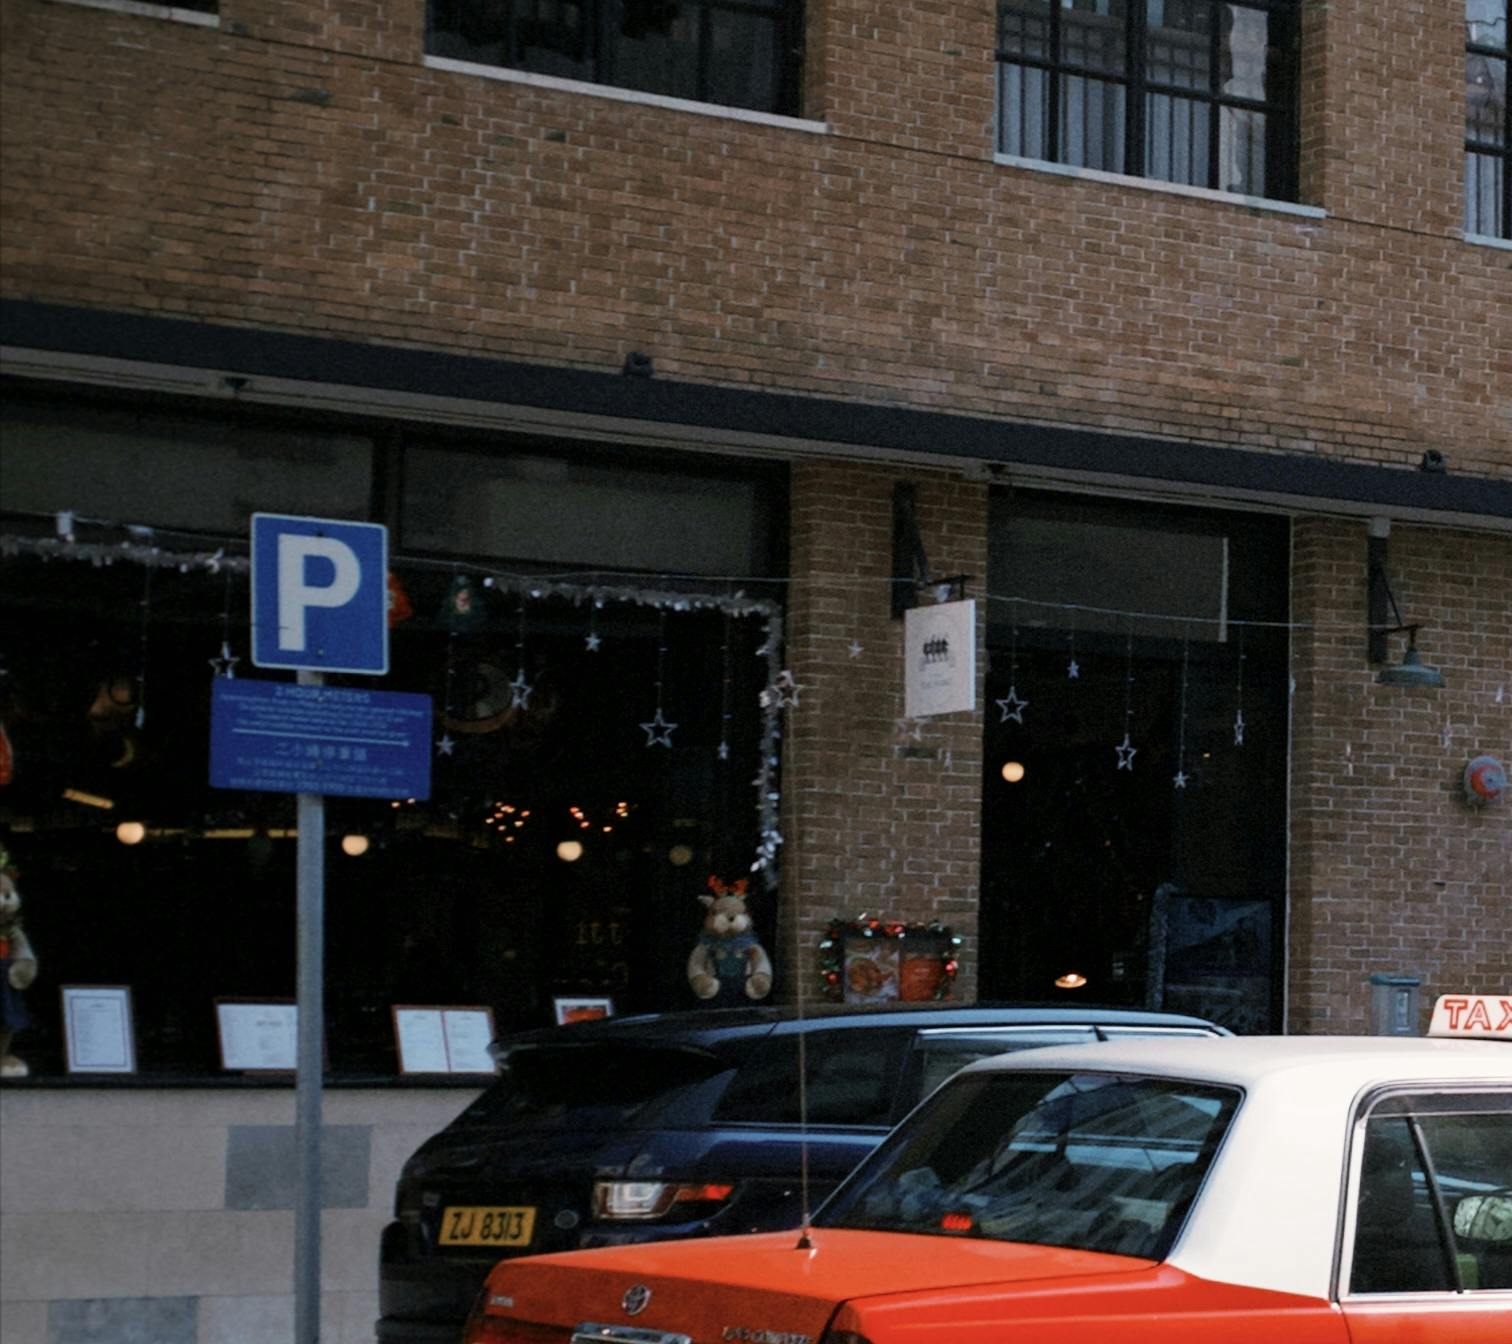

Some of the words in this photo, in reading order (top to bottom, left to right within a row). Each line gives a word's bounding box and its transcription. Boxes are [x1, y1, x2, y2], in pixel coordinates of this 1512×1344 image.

[277, 533, 361, 652] P
[448, 1209, 475, 1242] ZJ
[479, 1209, 524, 1241] 8313
